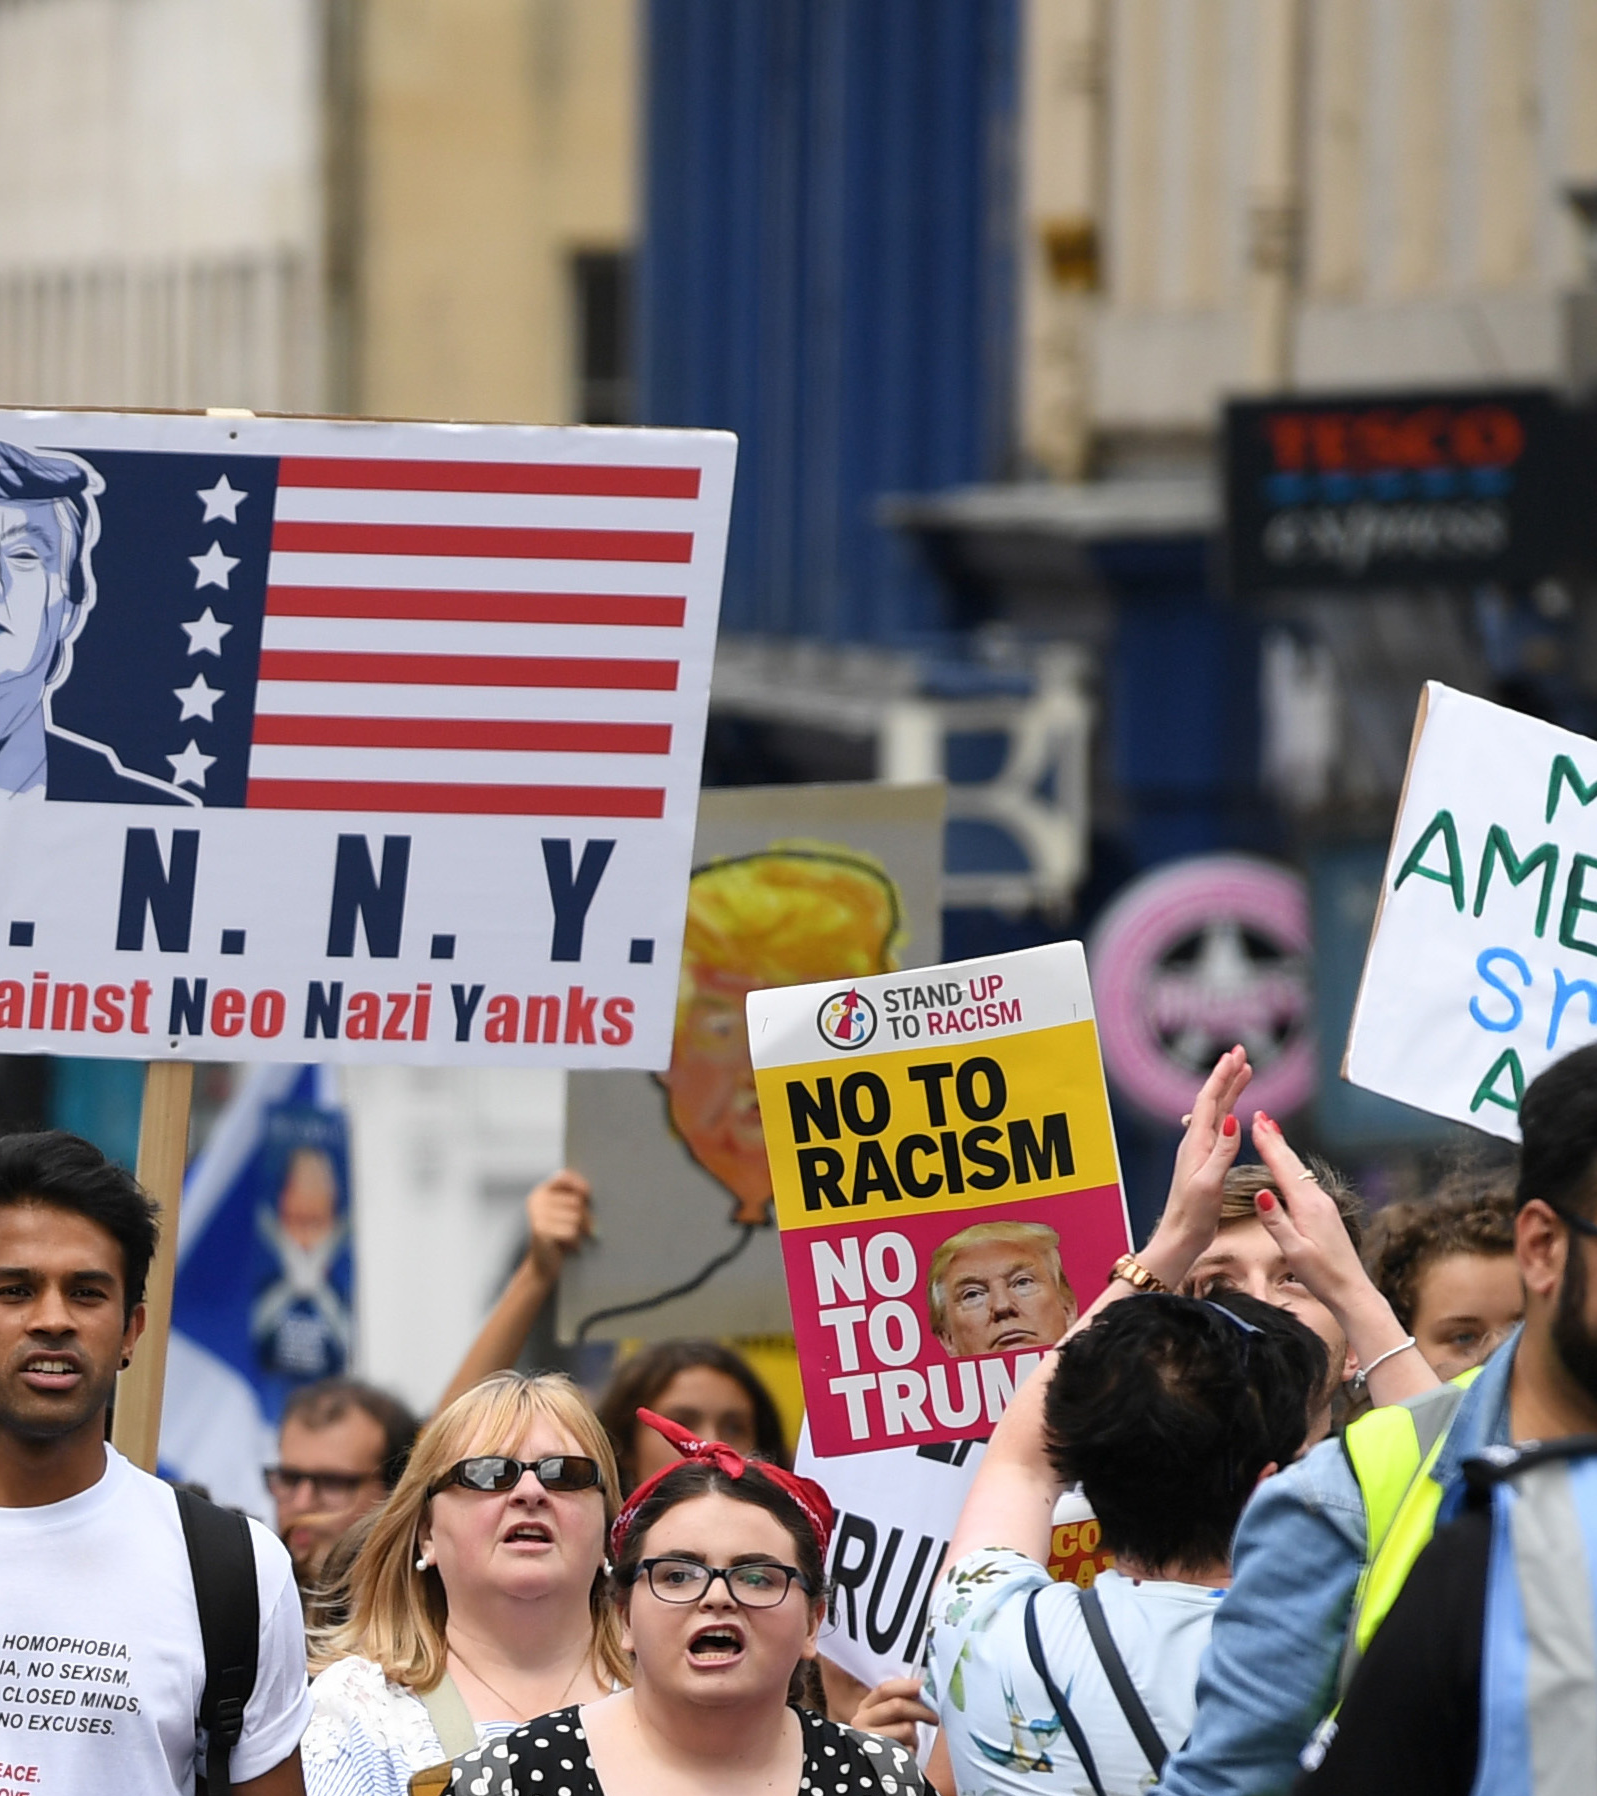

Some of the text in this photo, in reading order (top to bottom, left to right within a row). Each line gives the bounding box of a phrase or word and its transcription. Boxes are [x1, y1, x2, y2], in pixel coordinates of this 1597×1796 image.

[115, 827, 246, 956] N.
[325, 834, 456, 960] N.
[540, 838, 655, 964] Y.
[168, 976, 286, 1039] Neo
[304, 981, 433, 1042] Nazi
[450, 982, 635, 1048] Yanks
[884, 975, 1004, 1012] STAND UP
[887, 999, 1023, 1042] TO RACISM
[786, 1056, 1008, 1144] NO TO
[796, 1112, 1077, 1212] RACISM
[809, 1231, 918, 1305] NO
[818, 1299, 922, 1372] TO
[827, 1348, 1045, 1441] TRUM
[3, 1634, 133, 1662] HOMOPHOBIA,
[27, 1662, 54, 1678] NO
[59, 1663, 131, 1688] SEXISM,
[3, 1685, 76, 1707] CLOSED
[80, 1690, 142, 1716] MINDS,
[28, 1714, 116, 1736] EXCUSES.
